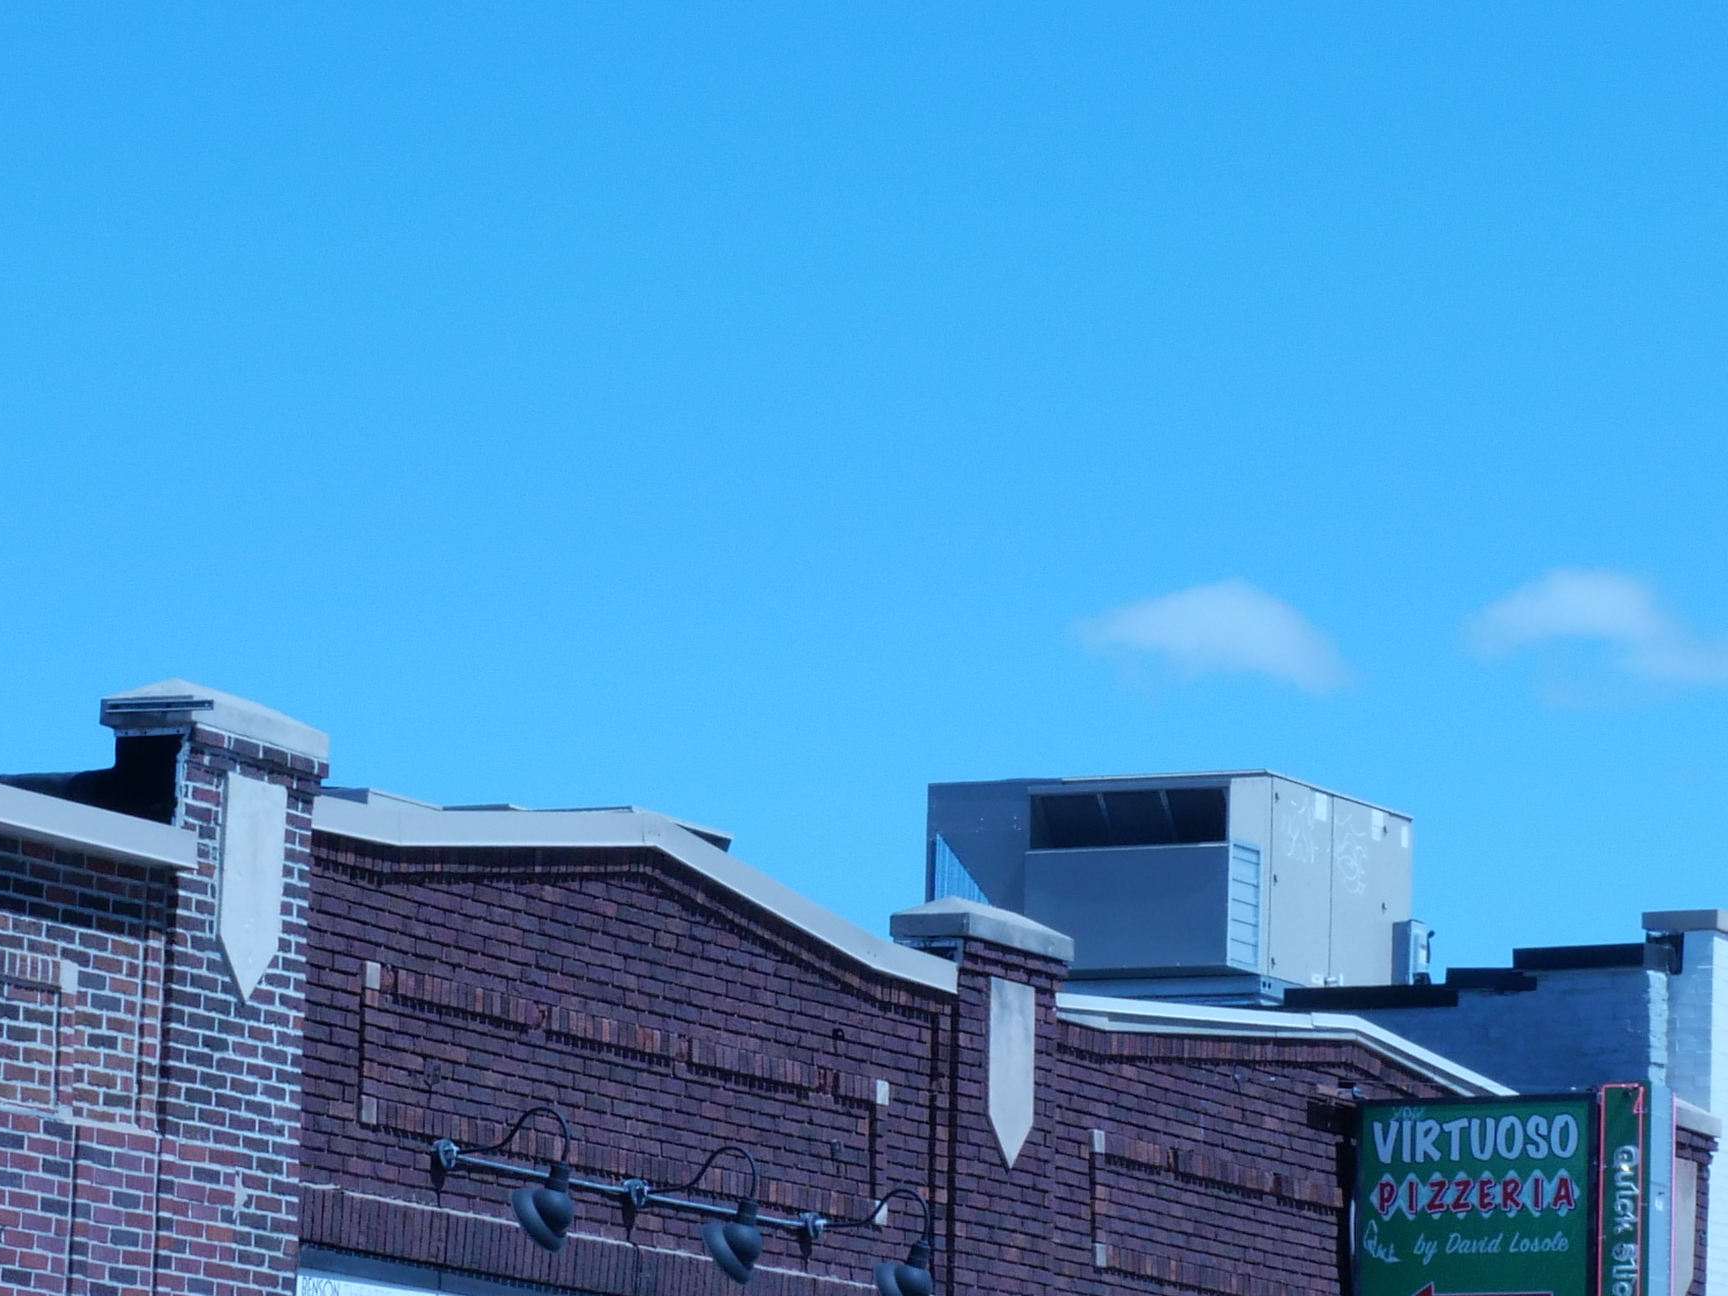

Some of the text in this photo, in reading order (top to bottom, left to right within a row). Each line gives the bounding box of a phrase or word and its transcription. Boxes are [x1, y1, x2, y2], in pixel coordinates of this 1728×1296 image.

[1373, 1113, 1579, 1164] VIRTUOSO
[1376, 1176, 1575, 1215] PIZZERIA
[1413, 1233, 1438, 1265] by
[1445, 1232, 1503, 1255] David
